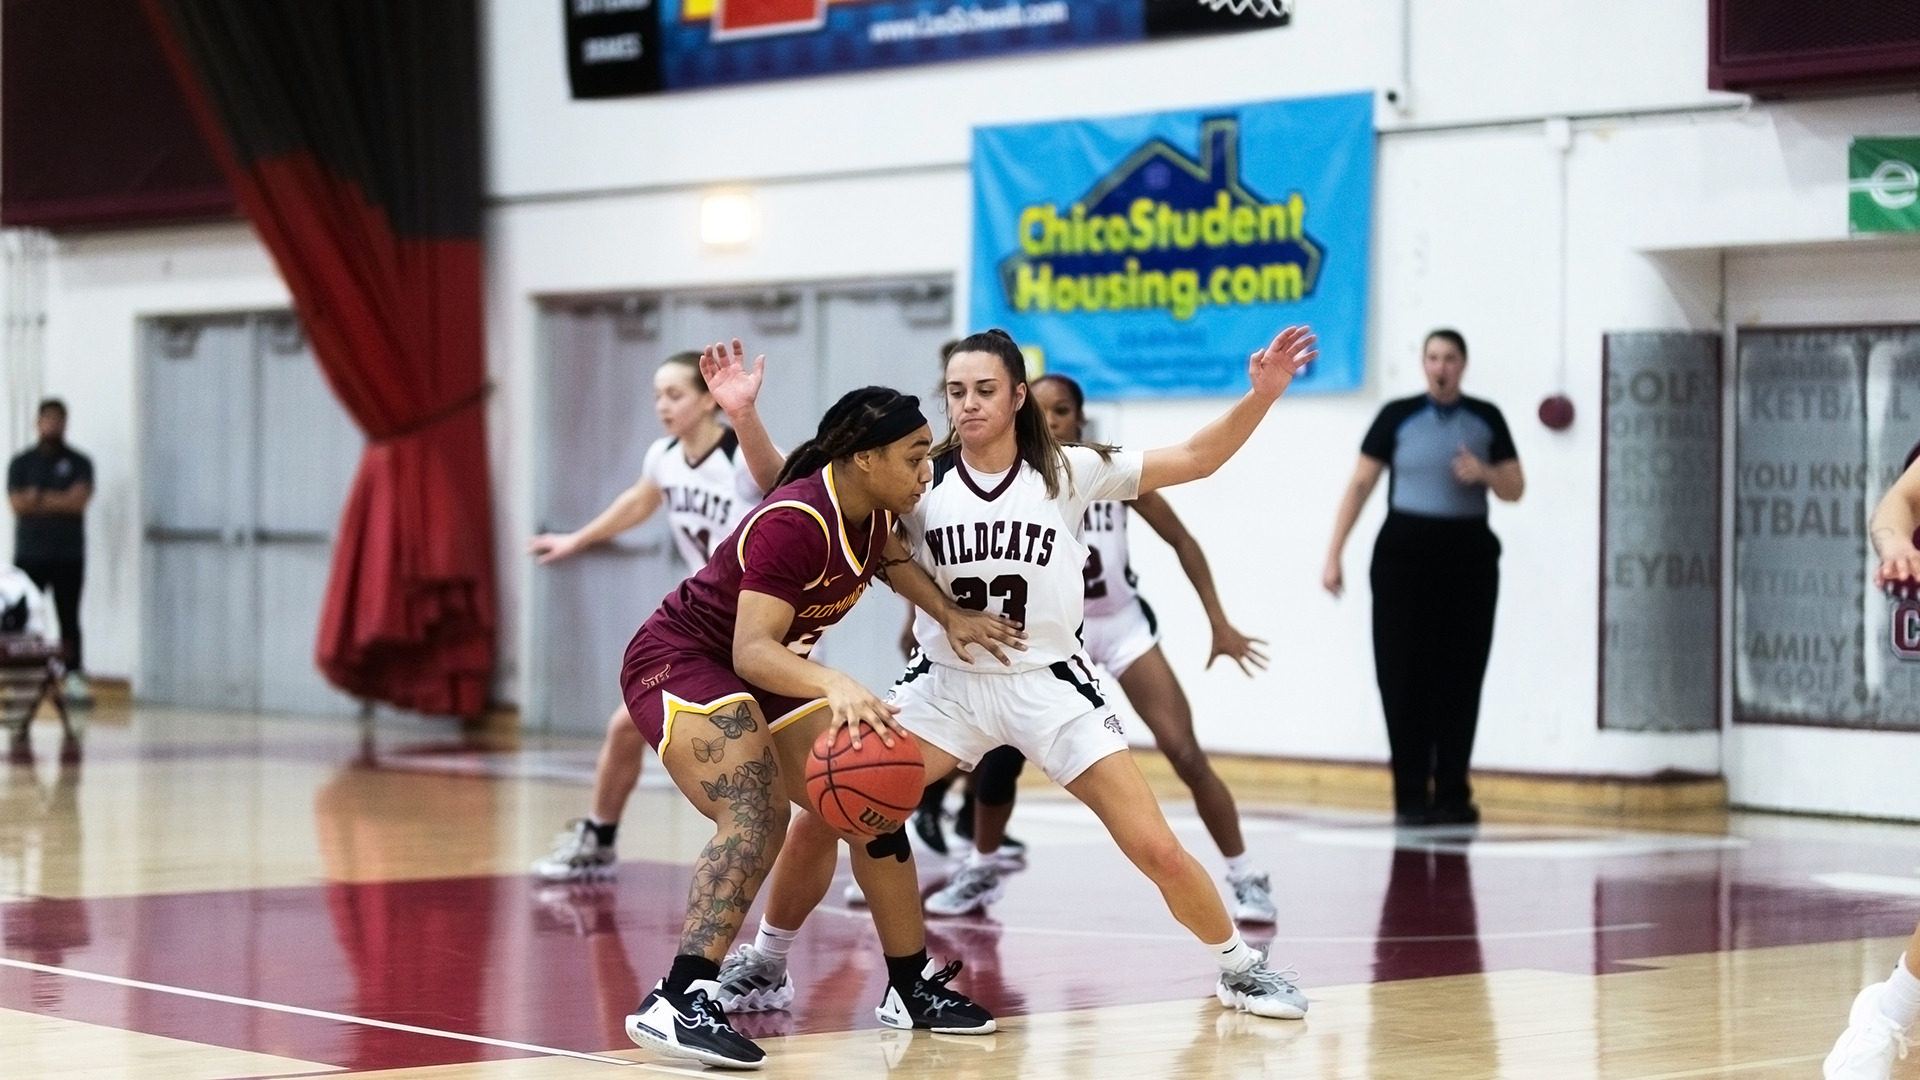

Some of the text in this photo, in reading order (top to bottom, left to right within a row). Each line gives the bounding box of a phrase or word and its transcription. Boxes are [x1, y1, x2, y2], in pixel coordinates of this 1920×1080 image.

[1018, 192, 1304, 256] ChicoStudent
[1014, 257, 1303, 320] Housing.com
[1740, 462, 1797, 491] YOU
[925, 520, 1056, 567] WILDCATS
[951, 574, 1028, 632] 23
